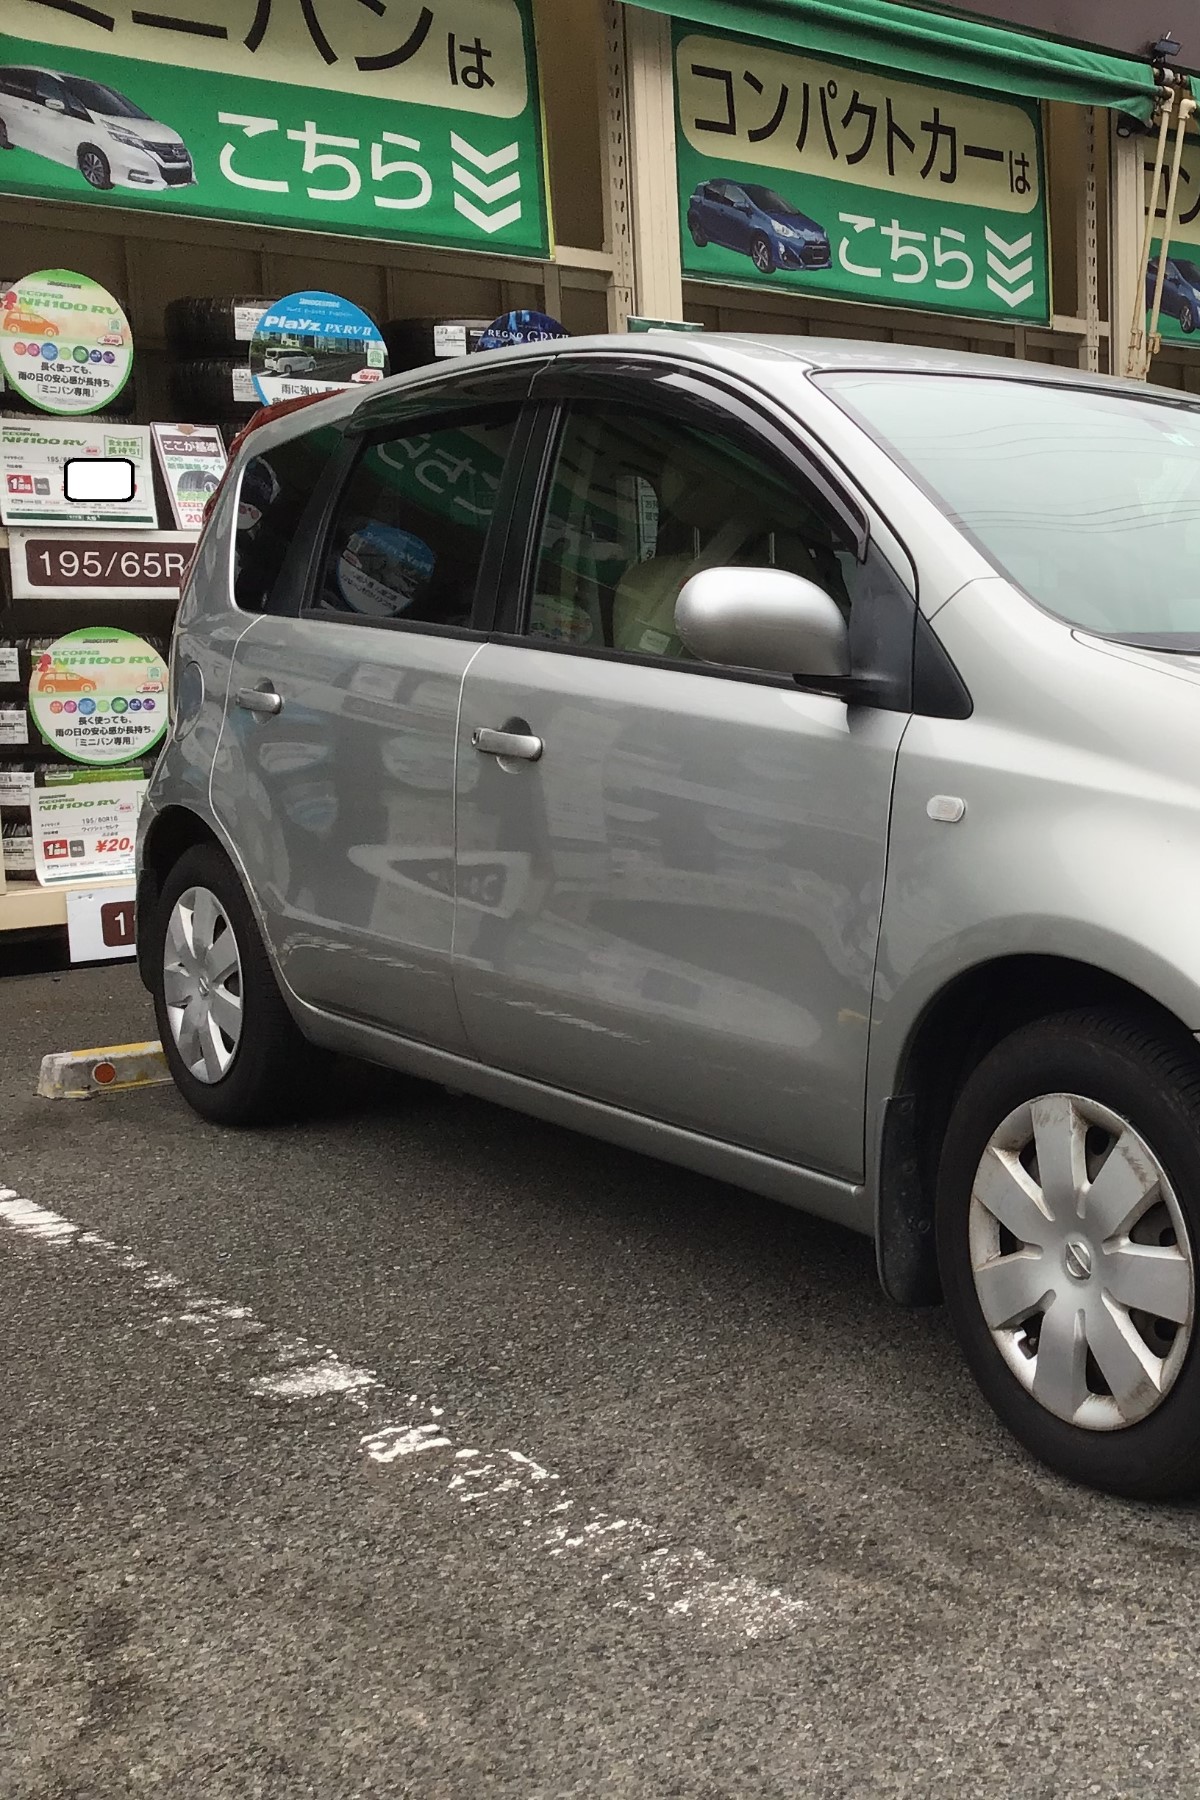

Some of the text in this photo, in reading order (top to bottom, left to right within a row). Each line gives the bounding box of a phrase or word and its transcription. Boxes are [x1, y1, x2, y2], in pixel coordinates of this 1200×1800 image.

[691, 64, 1031, 195] コンパクトカーは
[217, 112, 433, 209] こちら
[838, 212, 974, 290] こちら
[19, 297, 88, 311] NH100
[488, 329, 524, 341] REGNO
[53, 656, 125, 665] NH100
